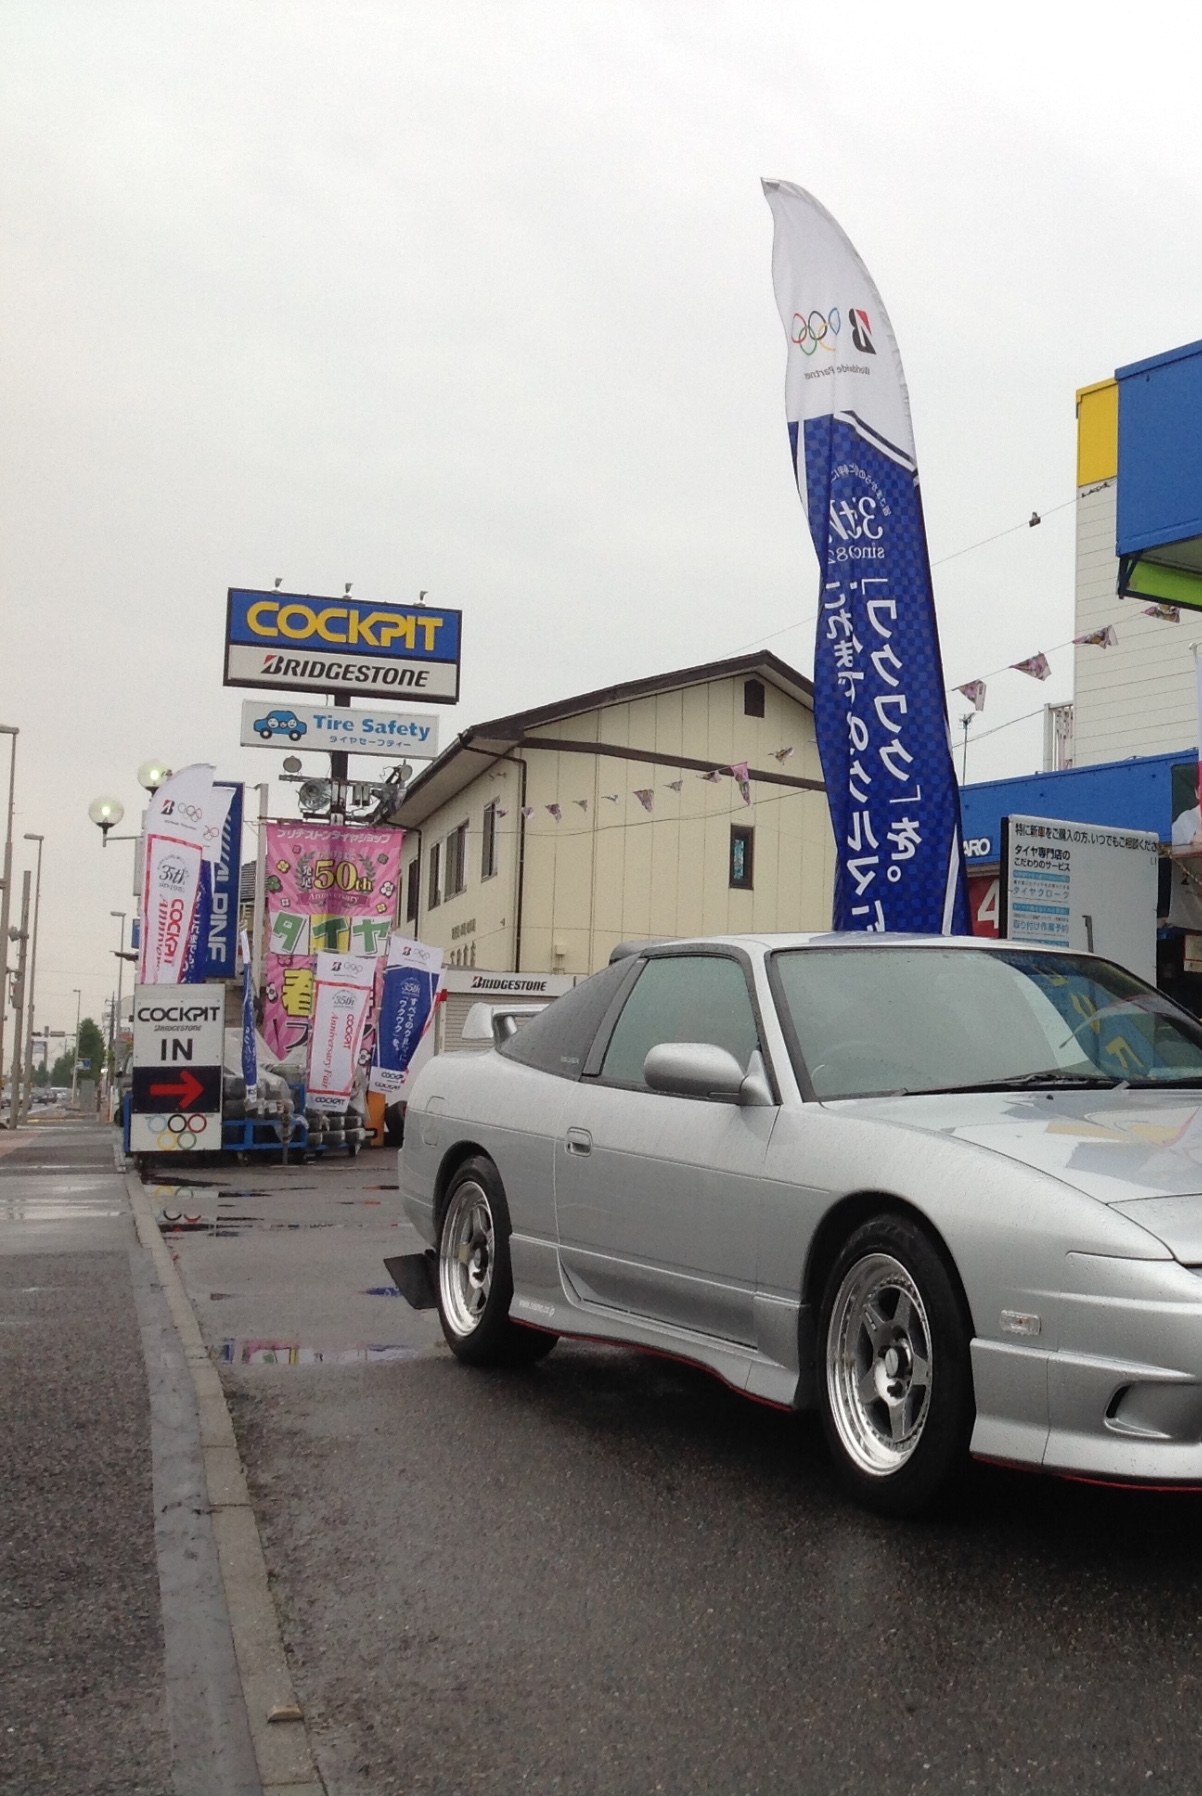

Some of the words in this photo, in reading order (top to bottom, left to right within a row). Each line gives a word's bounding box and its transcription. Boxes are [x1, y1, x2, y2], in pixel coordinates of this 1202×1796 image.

[247, 601, 443, 651] COCKPIT
[260, 655, 429, 688] BRIDGESTONE
[313, 714, 354, 731] Tire
[362, 718, 431, 741] Safety
[329, 735, 412, 749] タイヤセーフティー
[963, 838, 991, 858] ARO
[1015, 844, 1071, 860] タイヤ専門店の
[314, 858, 373, 891] 50th
[1014, 857, 1071, 872] こだわりのサービス
[163, 898, 184, 968] COCKPIT
[273, 910, 392, 954] タイヤ
[471, 976, 547, 991] BRIDGESTONE
[138, 1007, 220, 1022] COCKPIT
[161, 1038, 193, 1061] IN
